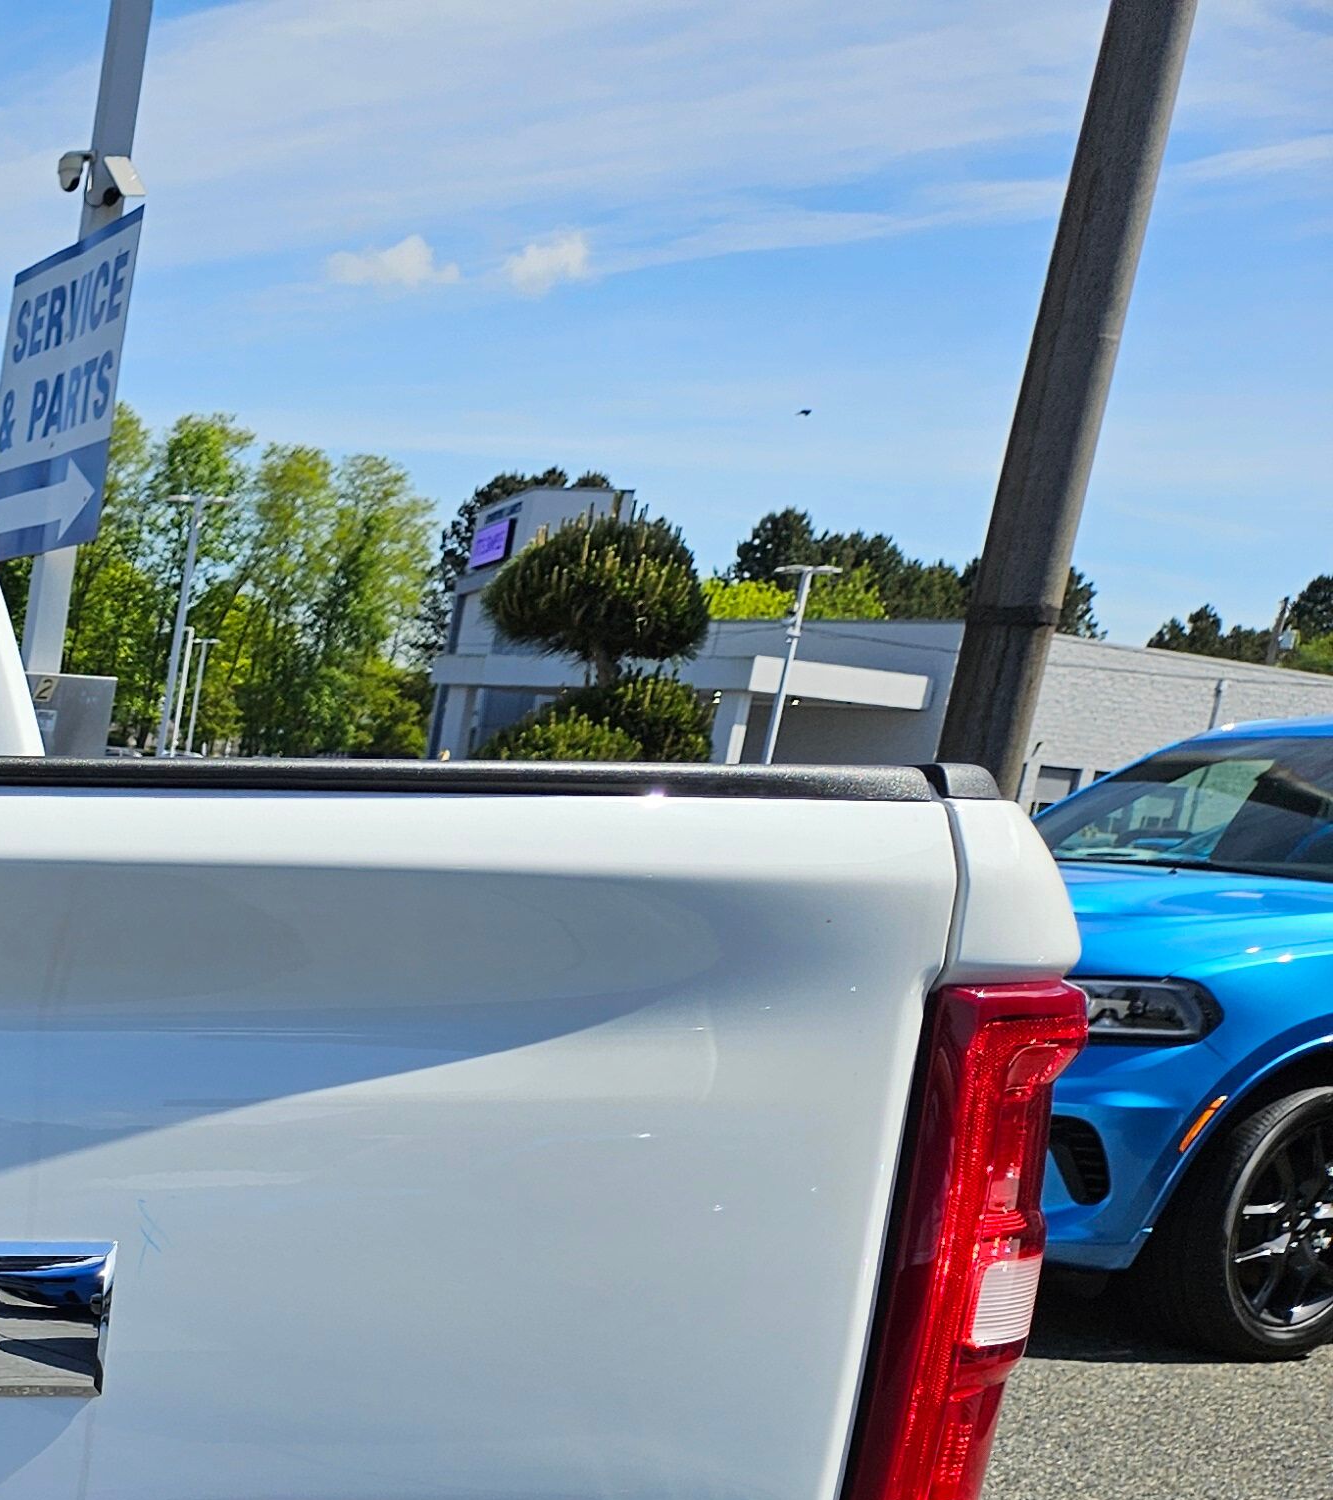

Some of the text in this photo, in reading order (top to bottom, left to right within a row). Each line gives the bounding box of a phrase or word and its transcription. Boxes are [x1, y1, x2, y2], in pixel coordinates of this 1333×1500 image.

[13, 248, 129, 363] SERVICE
[27, 350, 113, 443] PARTS
[35, 678, 54, 700] 2
